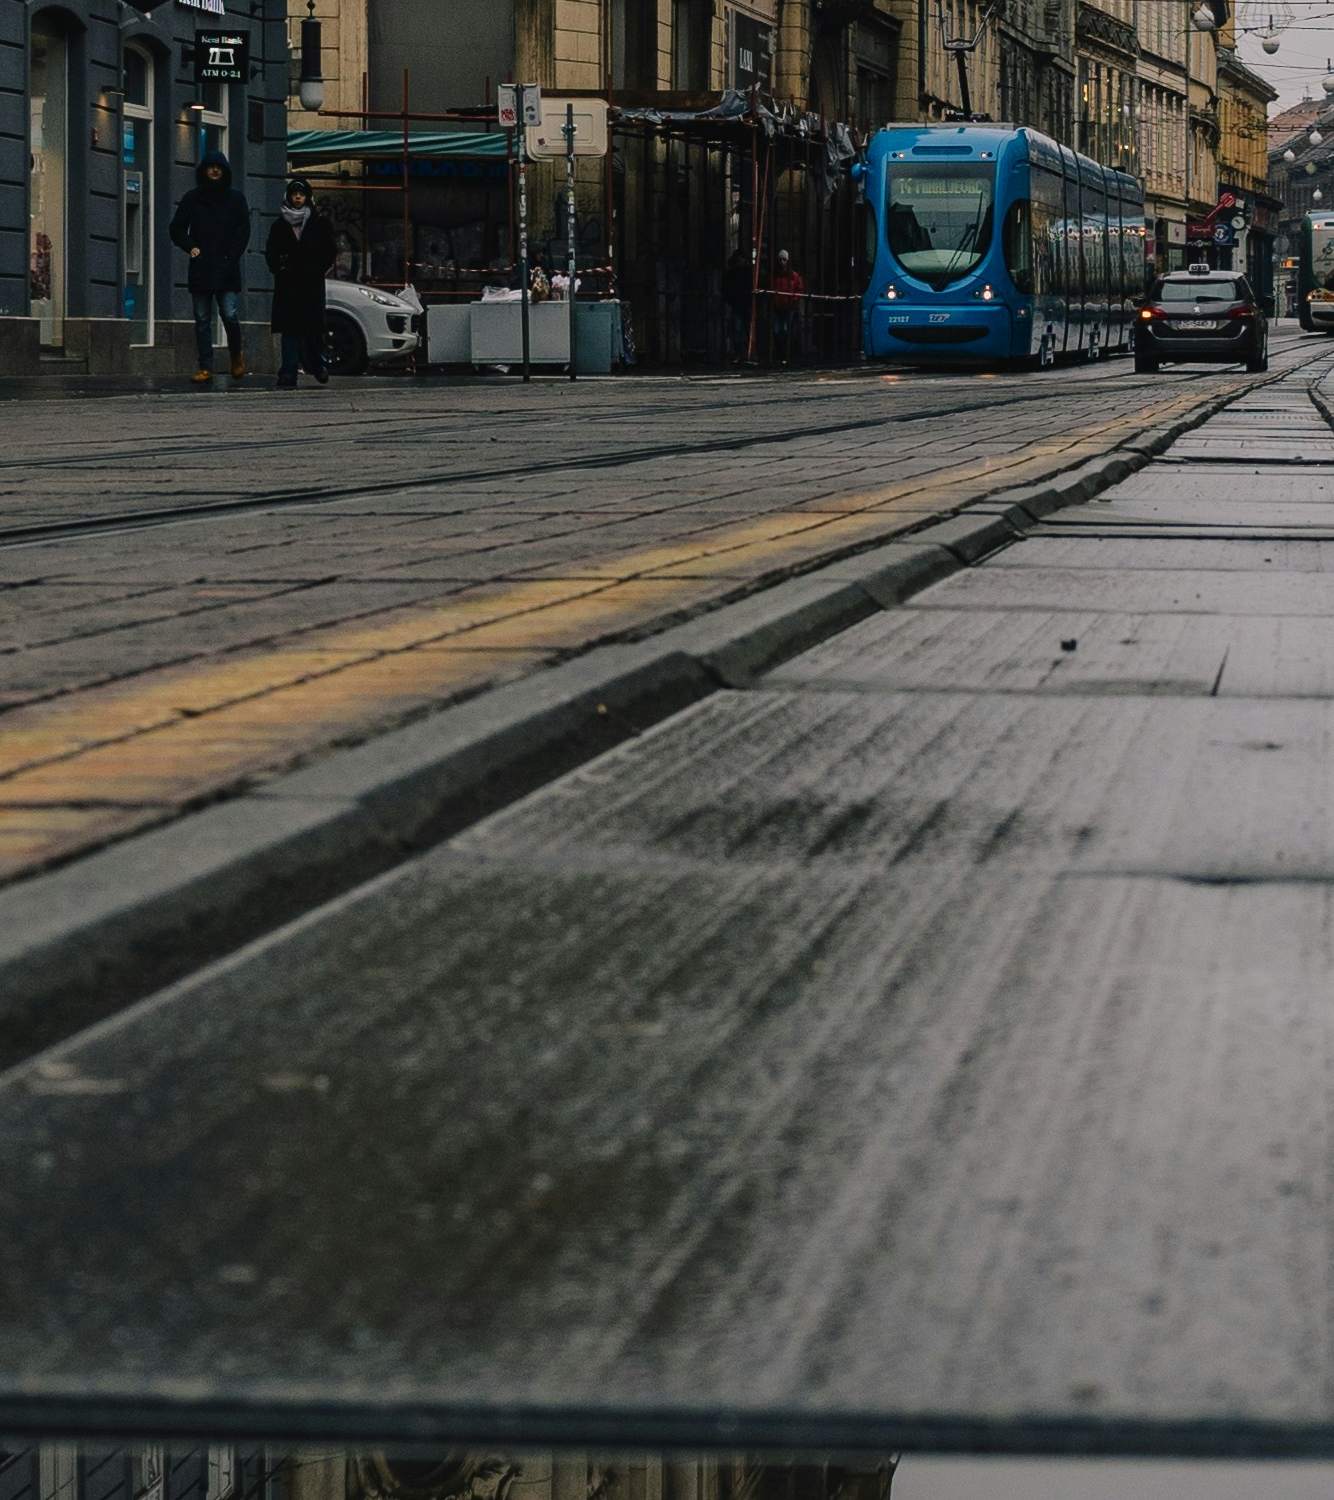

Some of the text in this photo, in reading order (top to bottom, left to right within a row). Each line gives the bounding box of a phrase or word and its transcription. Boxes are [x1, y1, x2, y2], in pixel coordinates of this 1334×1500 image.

[201, 36, 244, 45] Kent Bank
[201, 69, 219, 77] ATM
